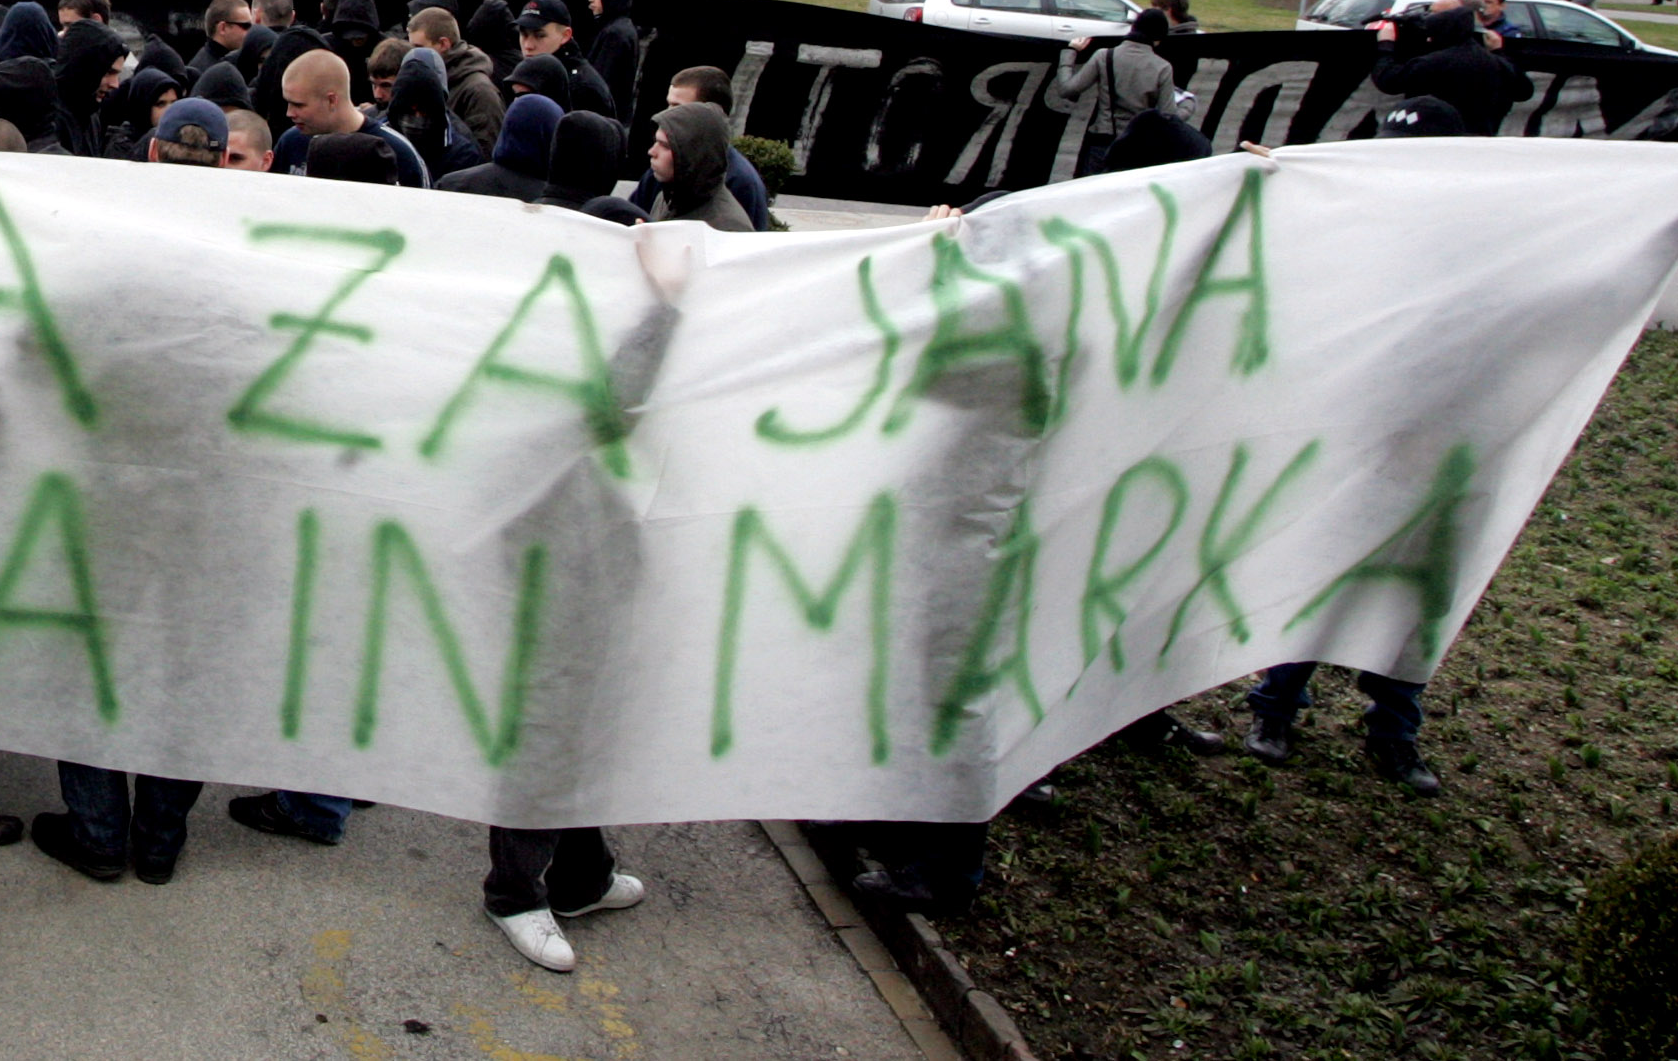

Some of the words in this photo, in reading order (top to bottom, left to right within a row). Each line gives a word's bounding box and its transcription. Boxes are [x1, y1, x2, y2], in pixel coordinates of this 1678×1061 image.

[225, 219, 639, 486] ZA
[752, 166, 1276, 454] JANA
[276, 505, 552, 772] IN
[708, 437, 1482, 768] MARKA
